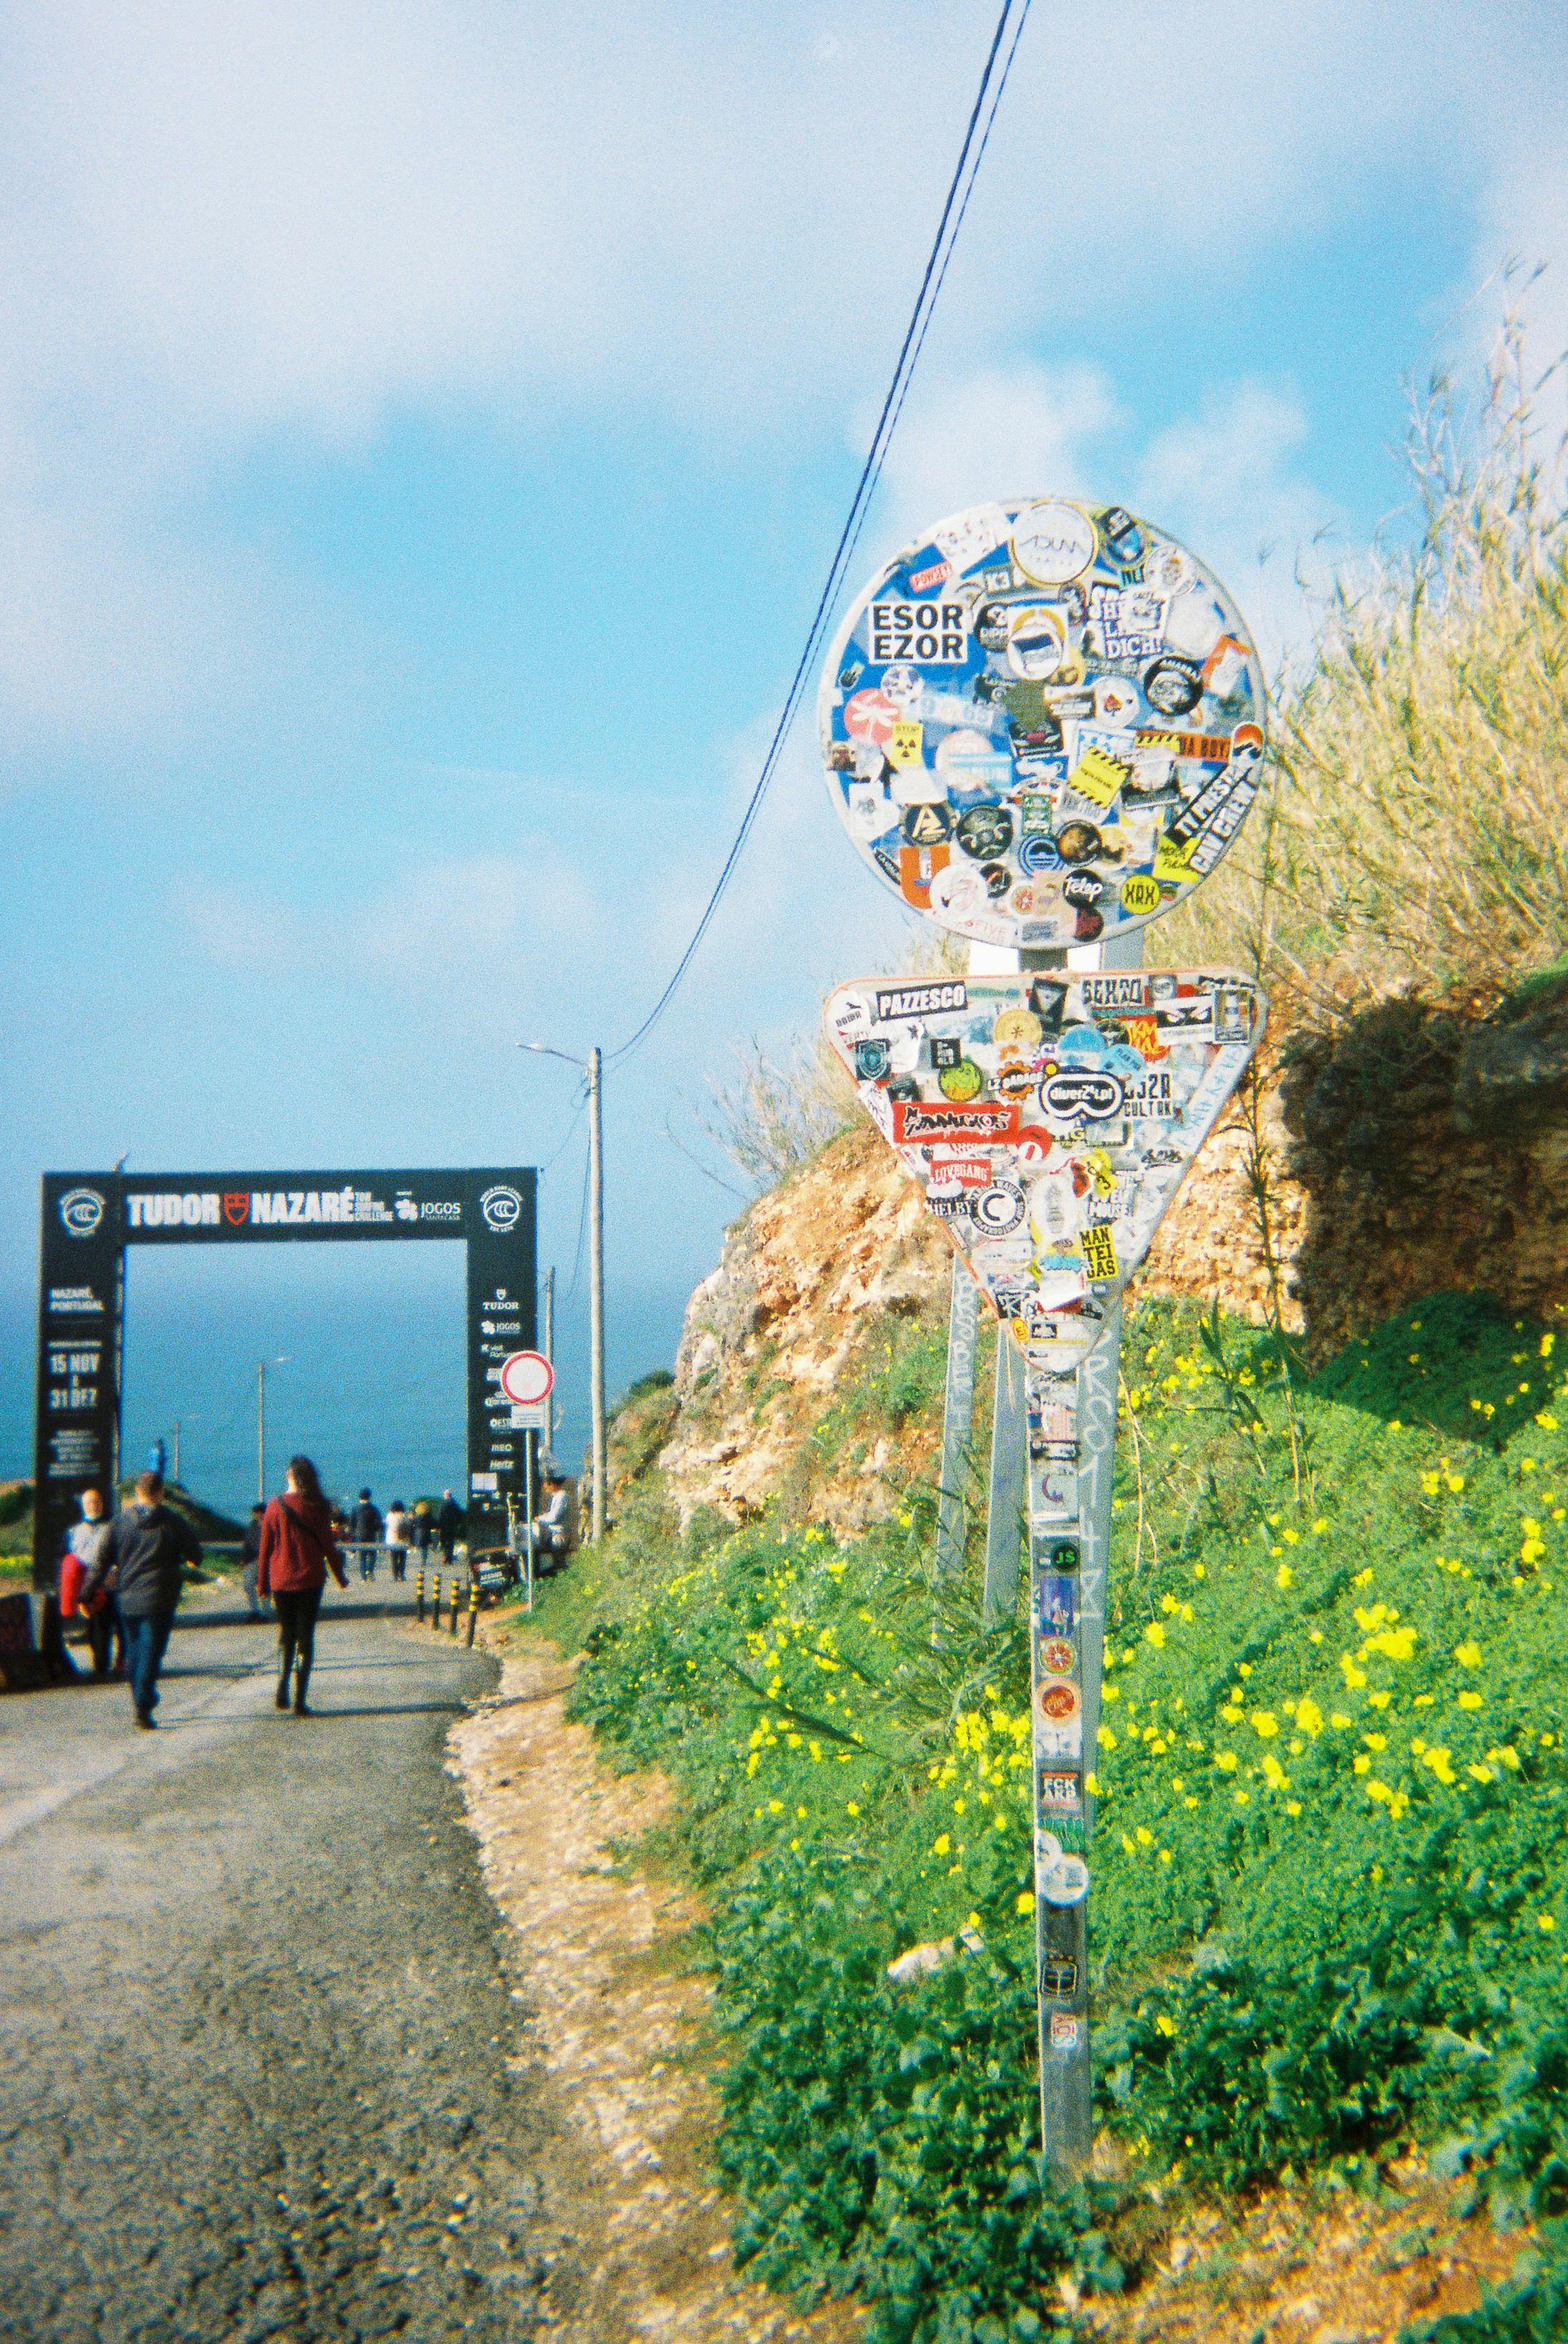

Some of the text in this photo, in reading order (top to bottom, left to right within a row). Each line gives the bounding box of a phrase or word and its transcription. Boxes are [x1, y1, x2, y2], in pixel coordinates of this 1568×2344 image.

[873, 604, 963, 631] ESOR
[874, 633, 963, 660] EZOR
[879, 985, 965, 1018] PAZZESCO
[126, 1193, 220, 1227] TUDOR
[251, 1186, 355, 1224] NAZARÉ
[421, 1202, 461, 1218] JOGOS
[1079, 1227, 1110, 1246] MAN
[1083, 1243, 1112, 1262] TEI
[482, 1301, 520, 1310] TUDOR
[51, 1353, 67, 1374] 15
